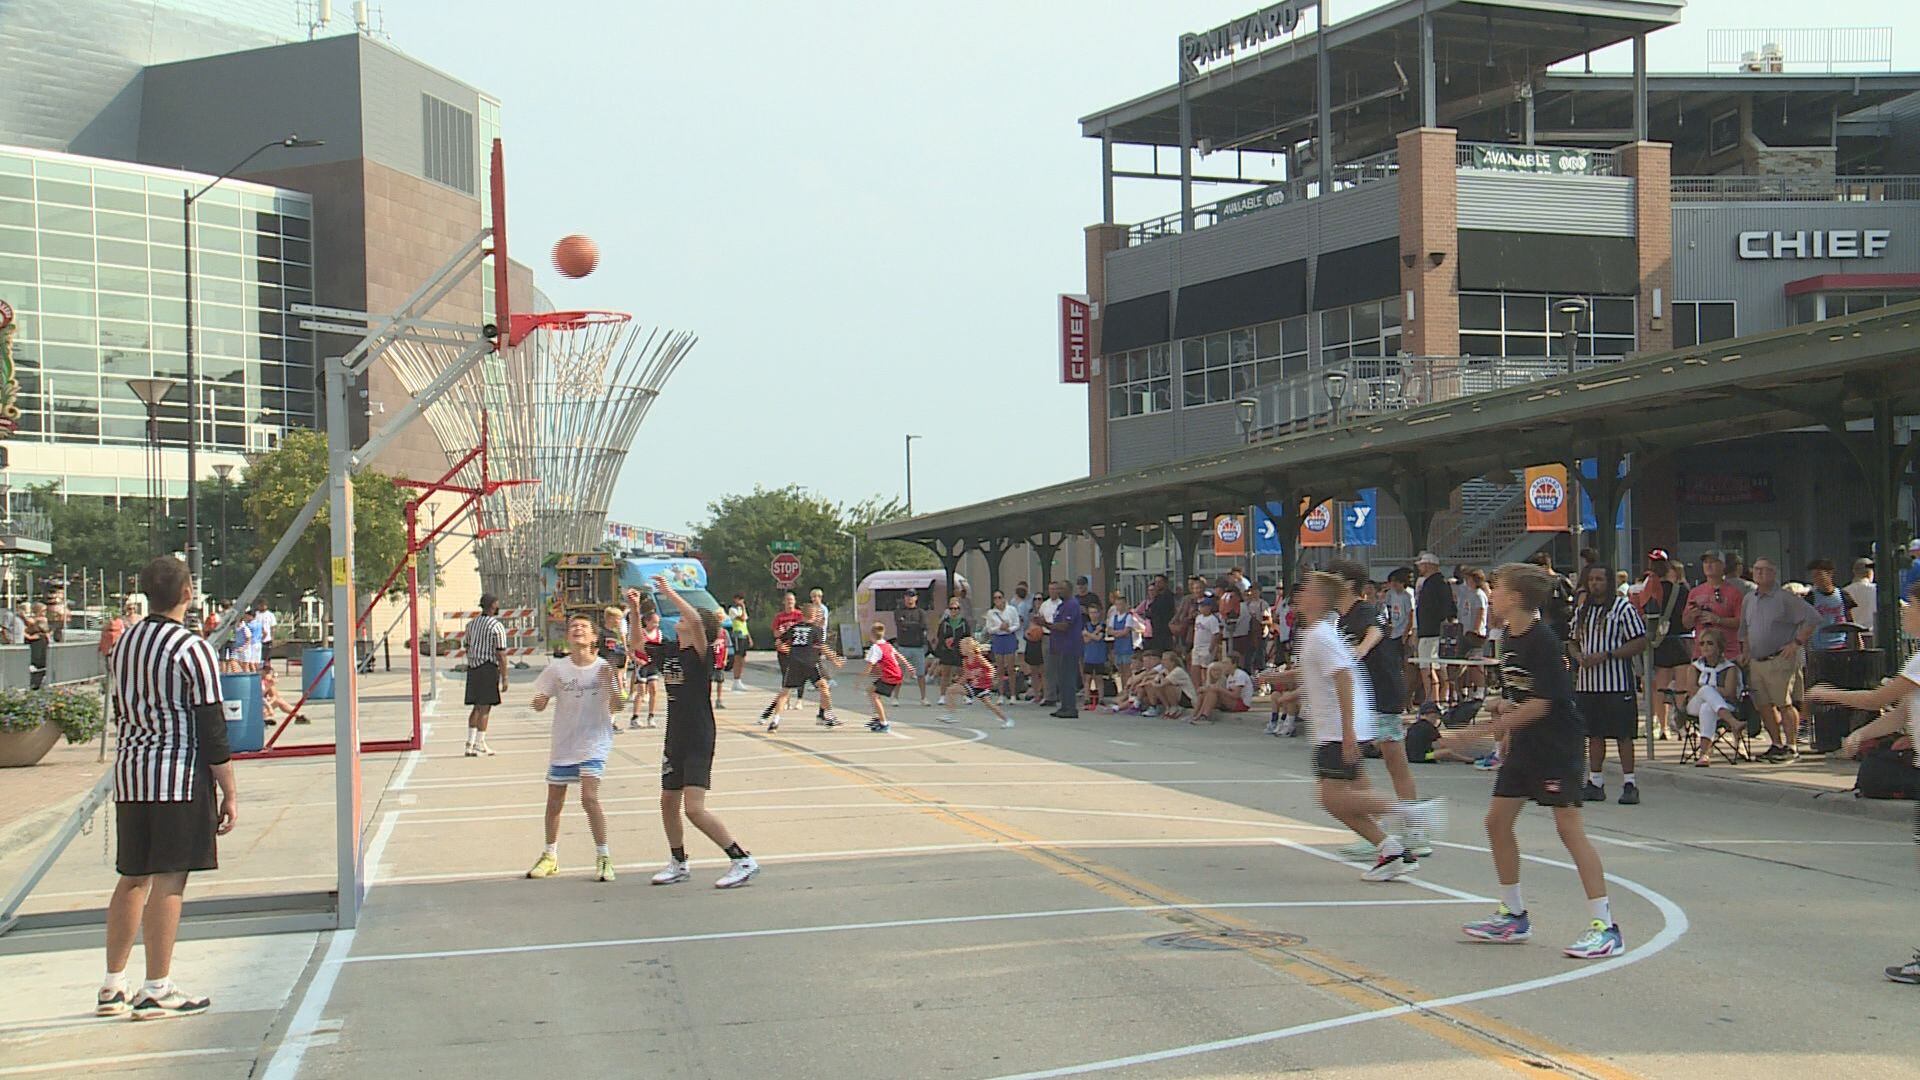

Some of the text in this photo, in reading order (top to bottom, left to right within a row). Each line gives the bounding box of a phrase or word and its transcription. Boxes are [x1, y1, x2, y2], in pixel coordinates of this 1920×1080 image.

[1739, 230, 1891, 259] CHIEF
[1070, 303, 1085, 379] CHIEF
[773, 562, 799, 574] STOP
